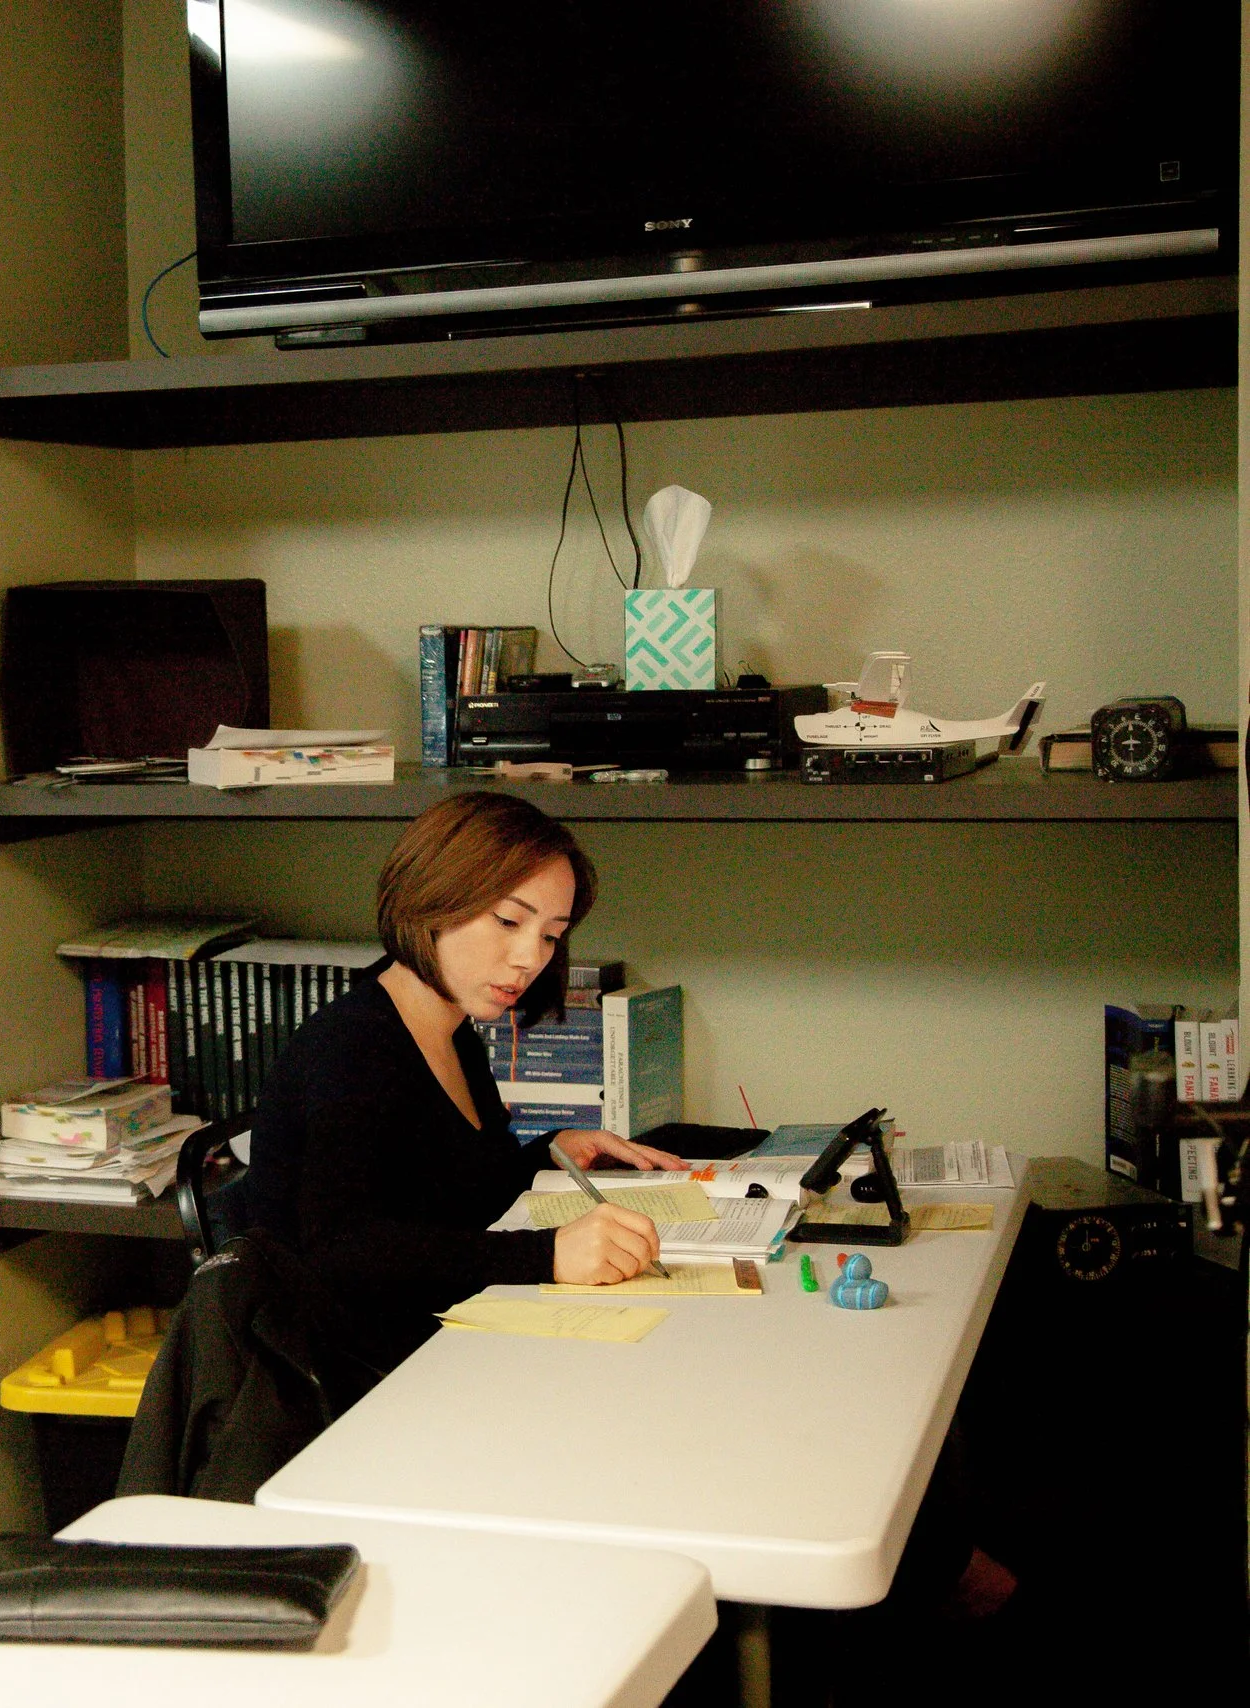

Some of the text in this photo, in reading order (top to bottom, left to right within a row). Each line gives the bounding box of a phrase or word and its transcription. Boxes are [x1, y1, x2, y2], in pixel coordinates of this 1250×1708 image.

[644, 218, 693, 232] SONY
[230, 962, 240, 997] AMERICA
[262, 964, 270, 978] THE
[326, 966, 334, 980] THE
[198, 962, 209, 1025] FLYING THE MAIL
[214, 977, 222, 997] FIRST
[186, 1005, 194, 1015] OF
[232, 999, 240, 1008] IN
[248, 995, 255, 1005] OF
[215, 998, 224, 1035] AVIATORS
[233, 1008, 241, 1024] THE
[248, 1006, 256, 1020] THE
[234, 1041, 243, 1061] WAR
[1183, 1031, 1195, 1102] BLOUNT FANAT
[1208, 1032, 1219, 1102] BLOUNT FANAT
[1226, 1059, 1236, 1089] LEARNING
[1187, 1145, 1198, 1180] PECTING
